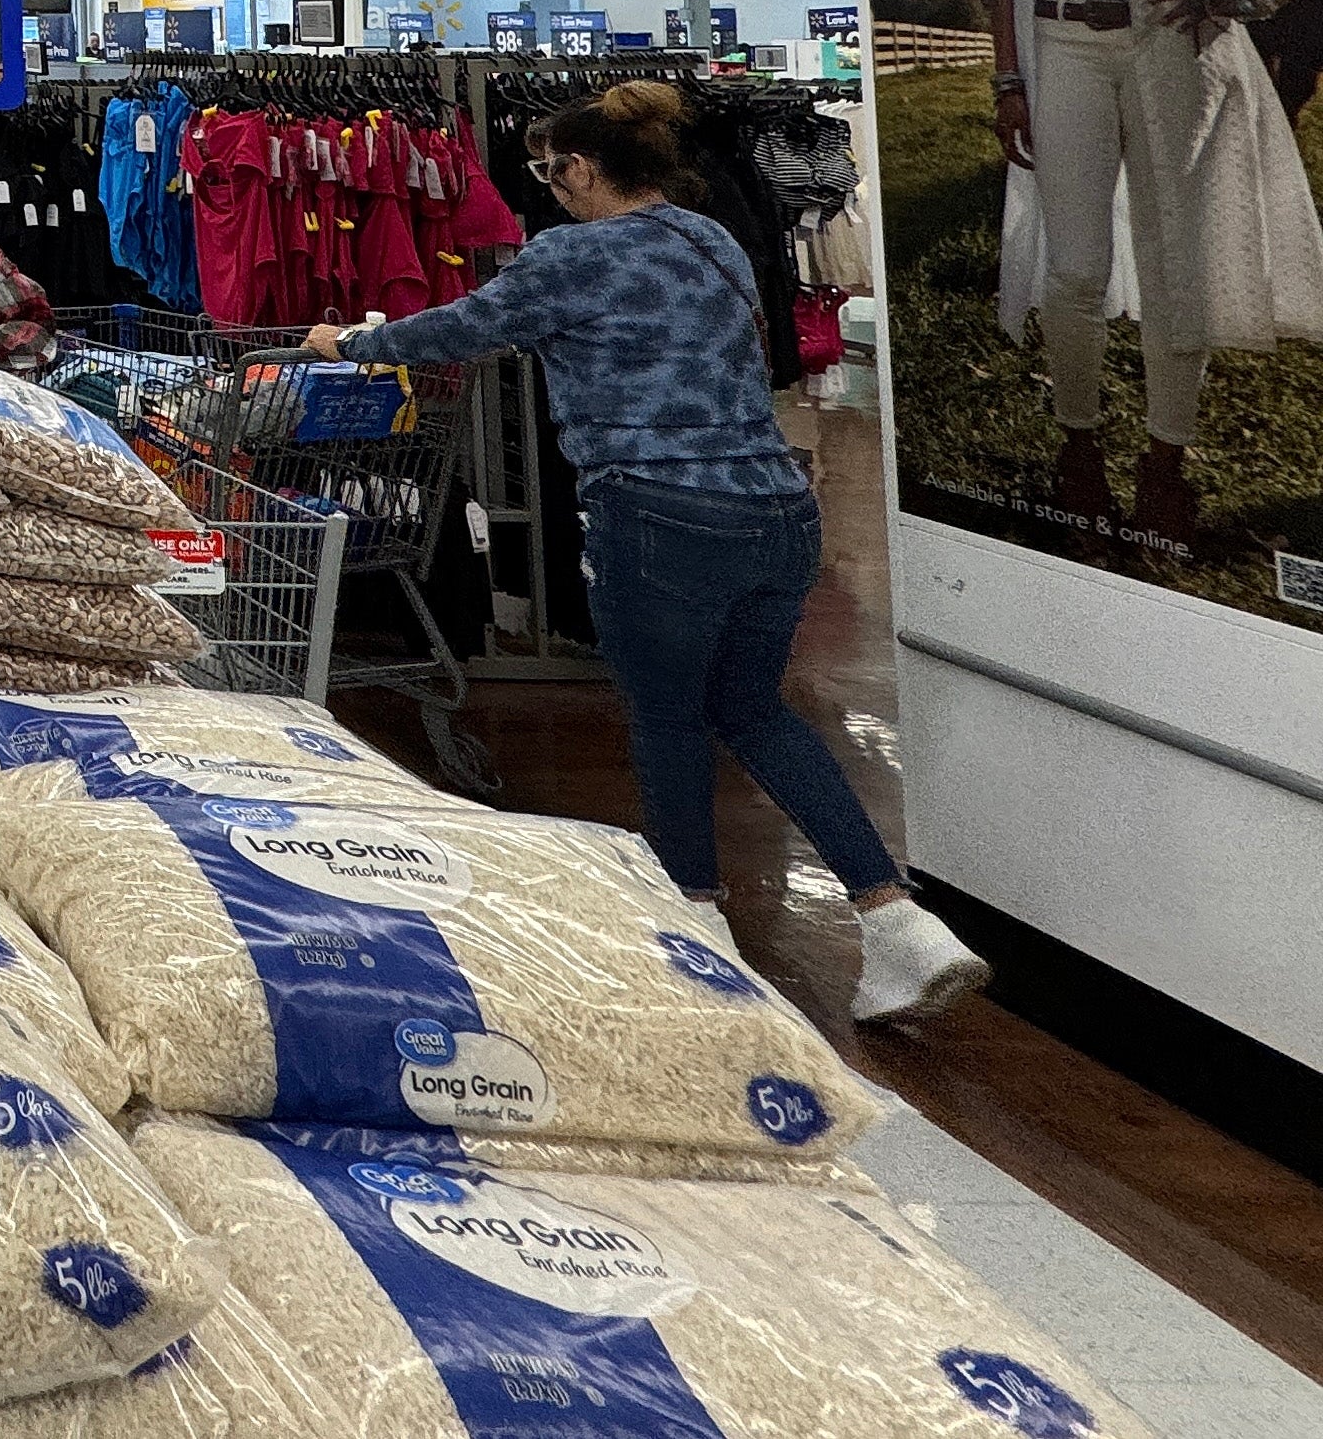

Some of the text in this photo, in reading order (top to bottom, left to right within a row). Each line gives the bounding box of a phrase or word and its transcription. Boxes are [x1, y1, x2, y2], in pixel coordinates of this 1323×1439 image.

[923, 471, 1195, 559] Available in store & online.
[179, 540, 216, 551] ONLY
[245, 834, 433, 865] Long Grain
[411, 1070, 533, 1102] Long Grain
[408, 1211, 643, 1254] Long Grain
